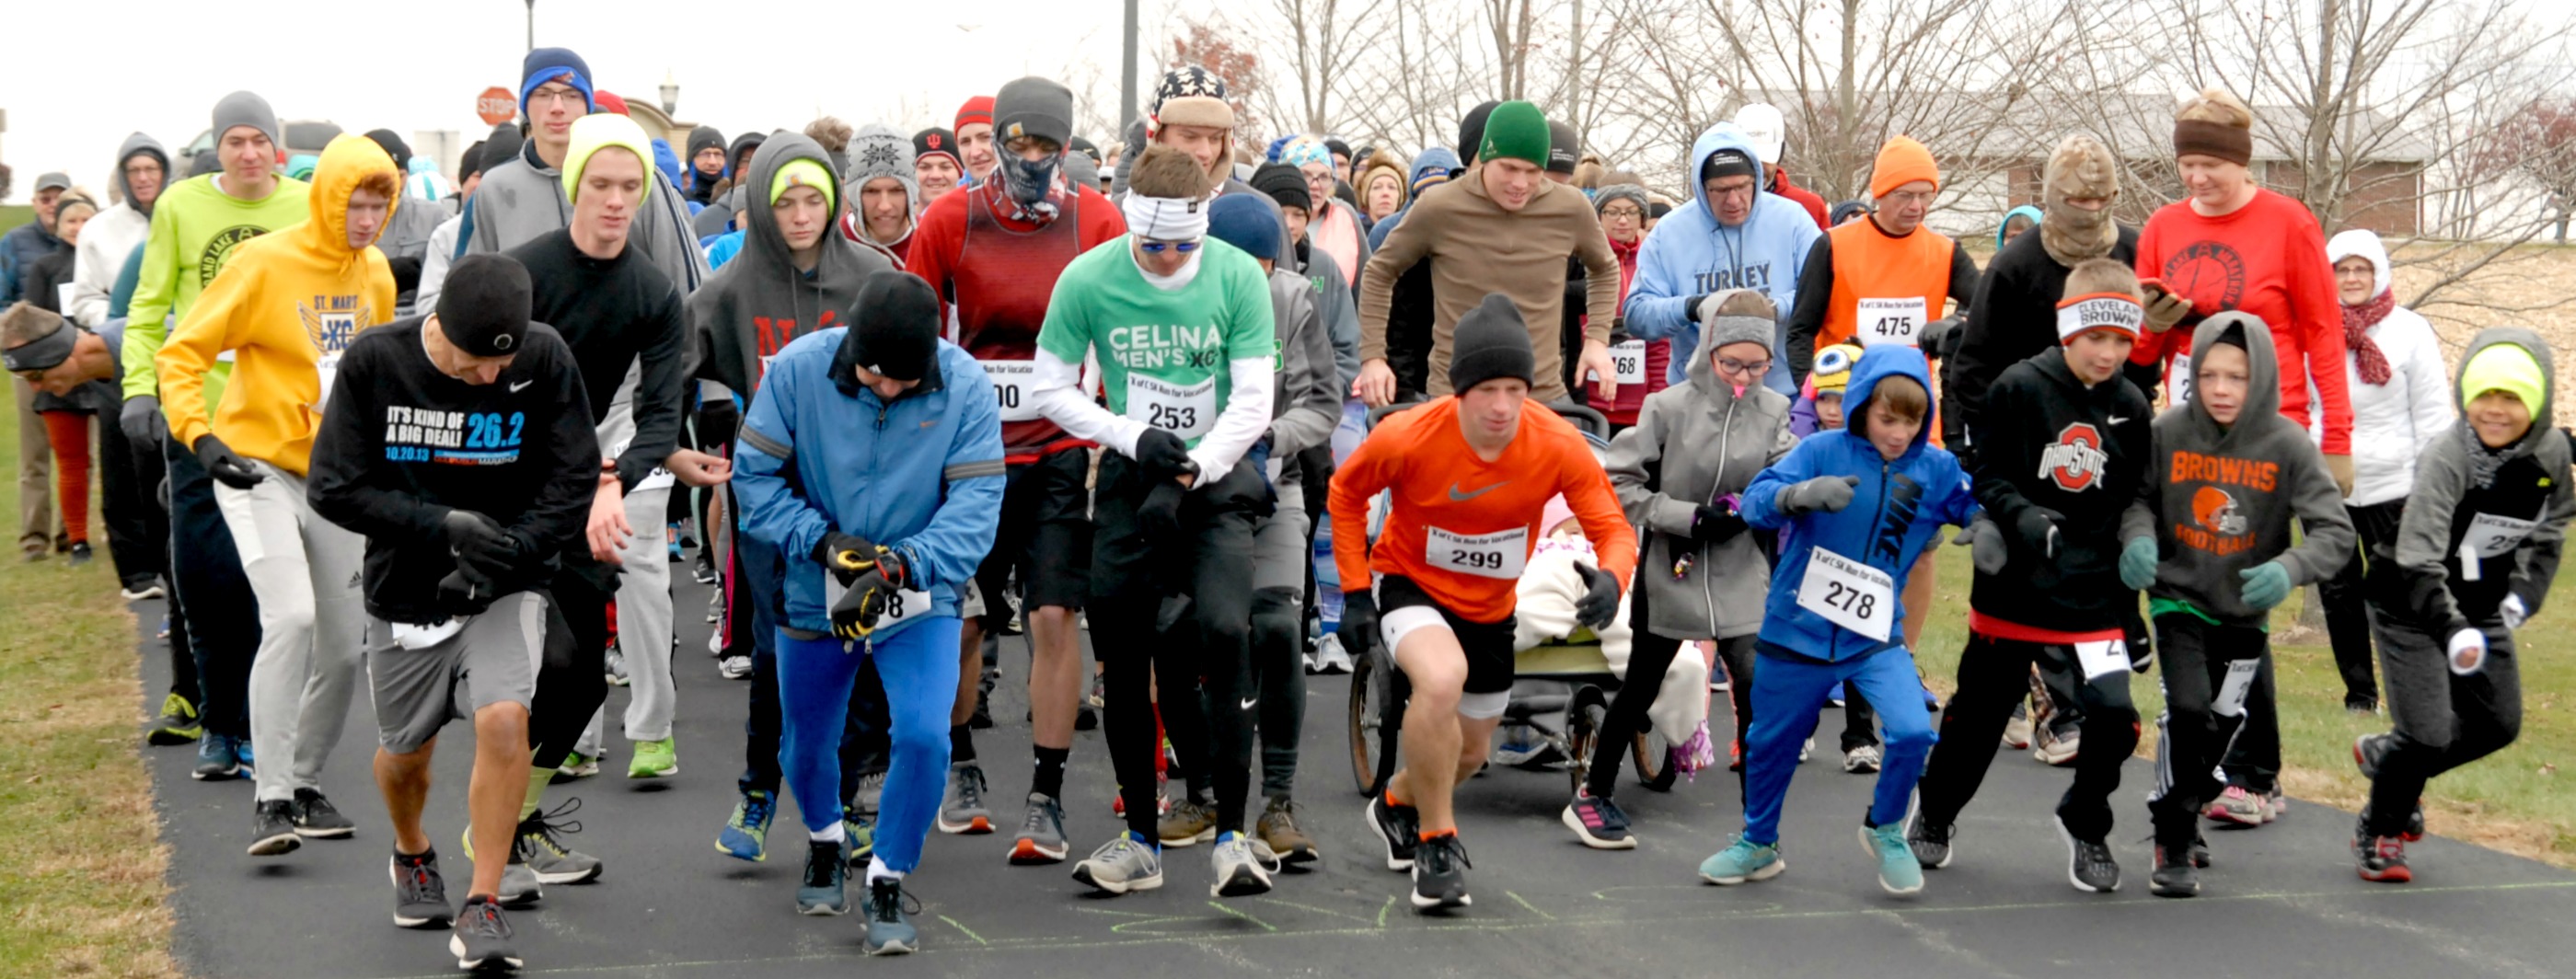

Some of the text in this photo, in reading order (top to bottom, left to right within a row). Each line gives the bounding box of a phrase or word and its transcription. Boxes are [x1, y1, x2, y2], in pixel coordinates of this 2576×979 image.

[478, 98, 516, 114] STOP
[208, 233, 234, 257] LAKE
[1694, 263, 1771, 294] TURKEY
[314, 295, 329, 310] ST.
[2078, 300, 2141, 314] CLEVELAN
[1108, 324, 1221, 351] CELINA
[1876, 317, 1911, 336] 475
[1112, 348, 1185, 367] MEN'S
[1618, 357, 1635, 374] 68
[997, 364, 1006, 374] for
[1160, 385, 1171, 396] Run
[1172, 388, 1182, 397] for
[387, 406, 464, 430] IT'S KIND OF
[1149, 402, 1196, 430] 253
[386, 424, 462, 448] A BIG DEAL!
[466, 411, 525, 448] 26.2
[386, 446, 430, 461] 10.20.13
[2170, 451, 2279, 492] BROWNS
[1874, 472, 1923, 569] NIKE
[1479, 536, 1489, 545] for
[1451, 549, 1502, 570] 299
[1821, 555, 1830, 564] of
[1845, 564, 1859, 576] Run
[1859, 570, 1870, 581] for
[1824, 581, 1875, 619] 278
